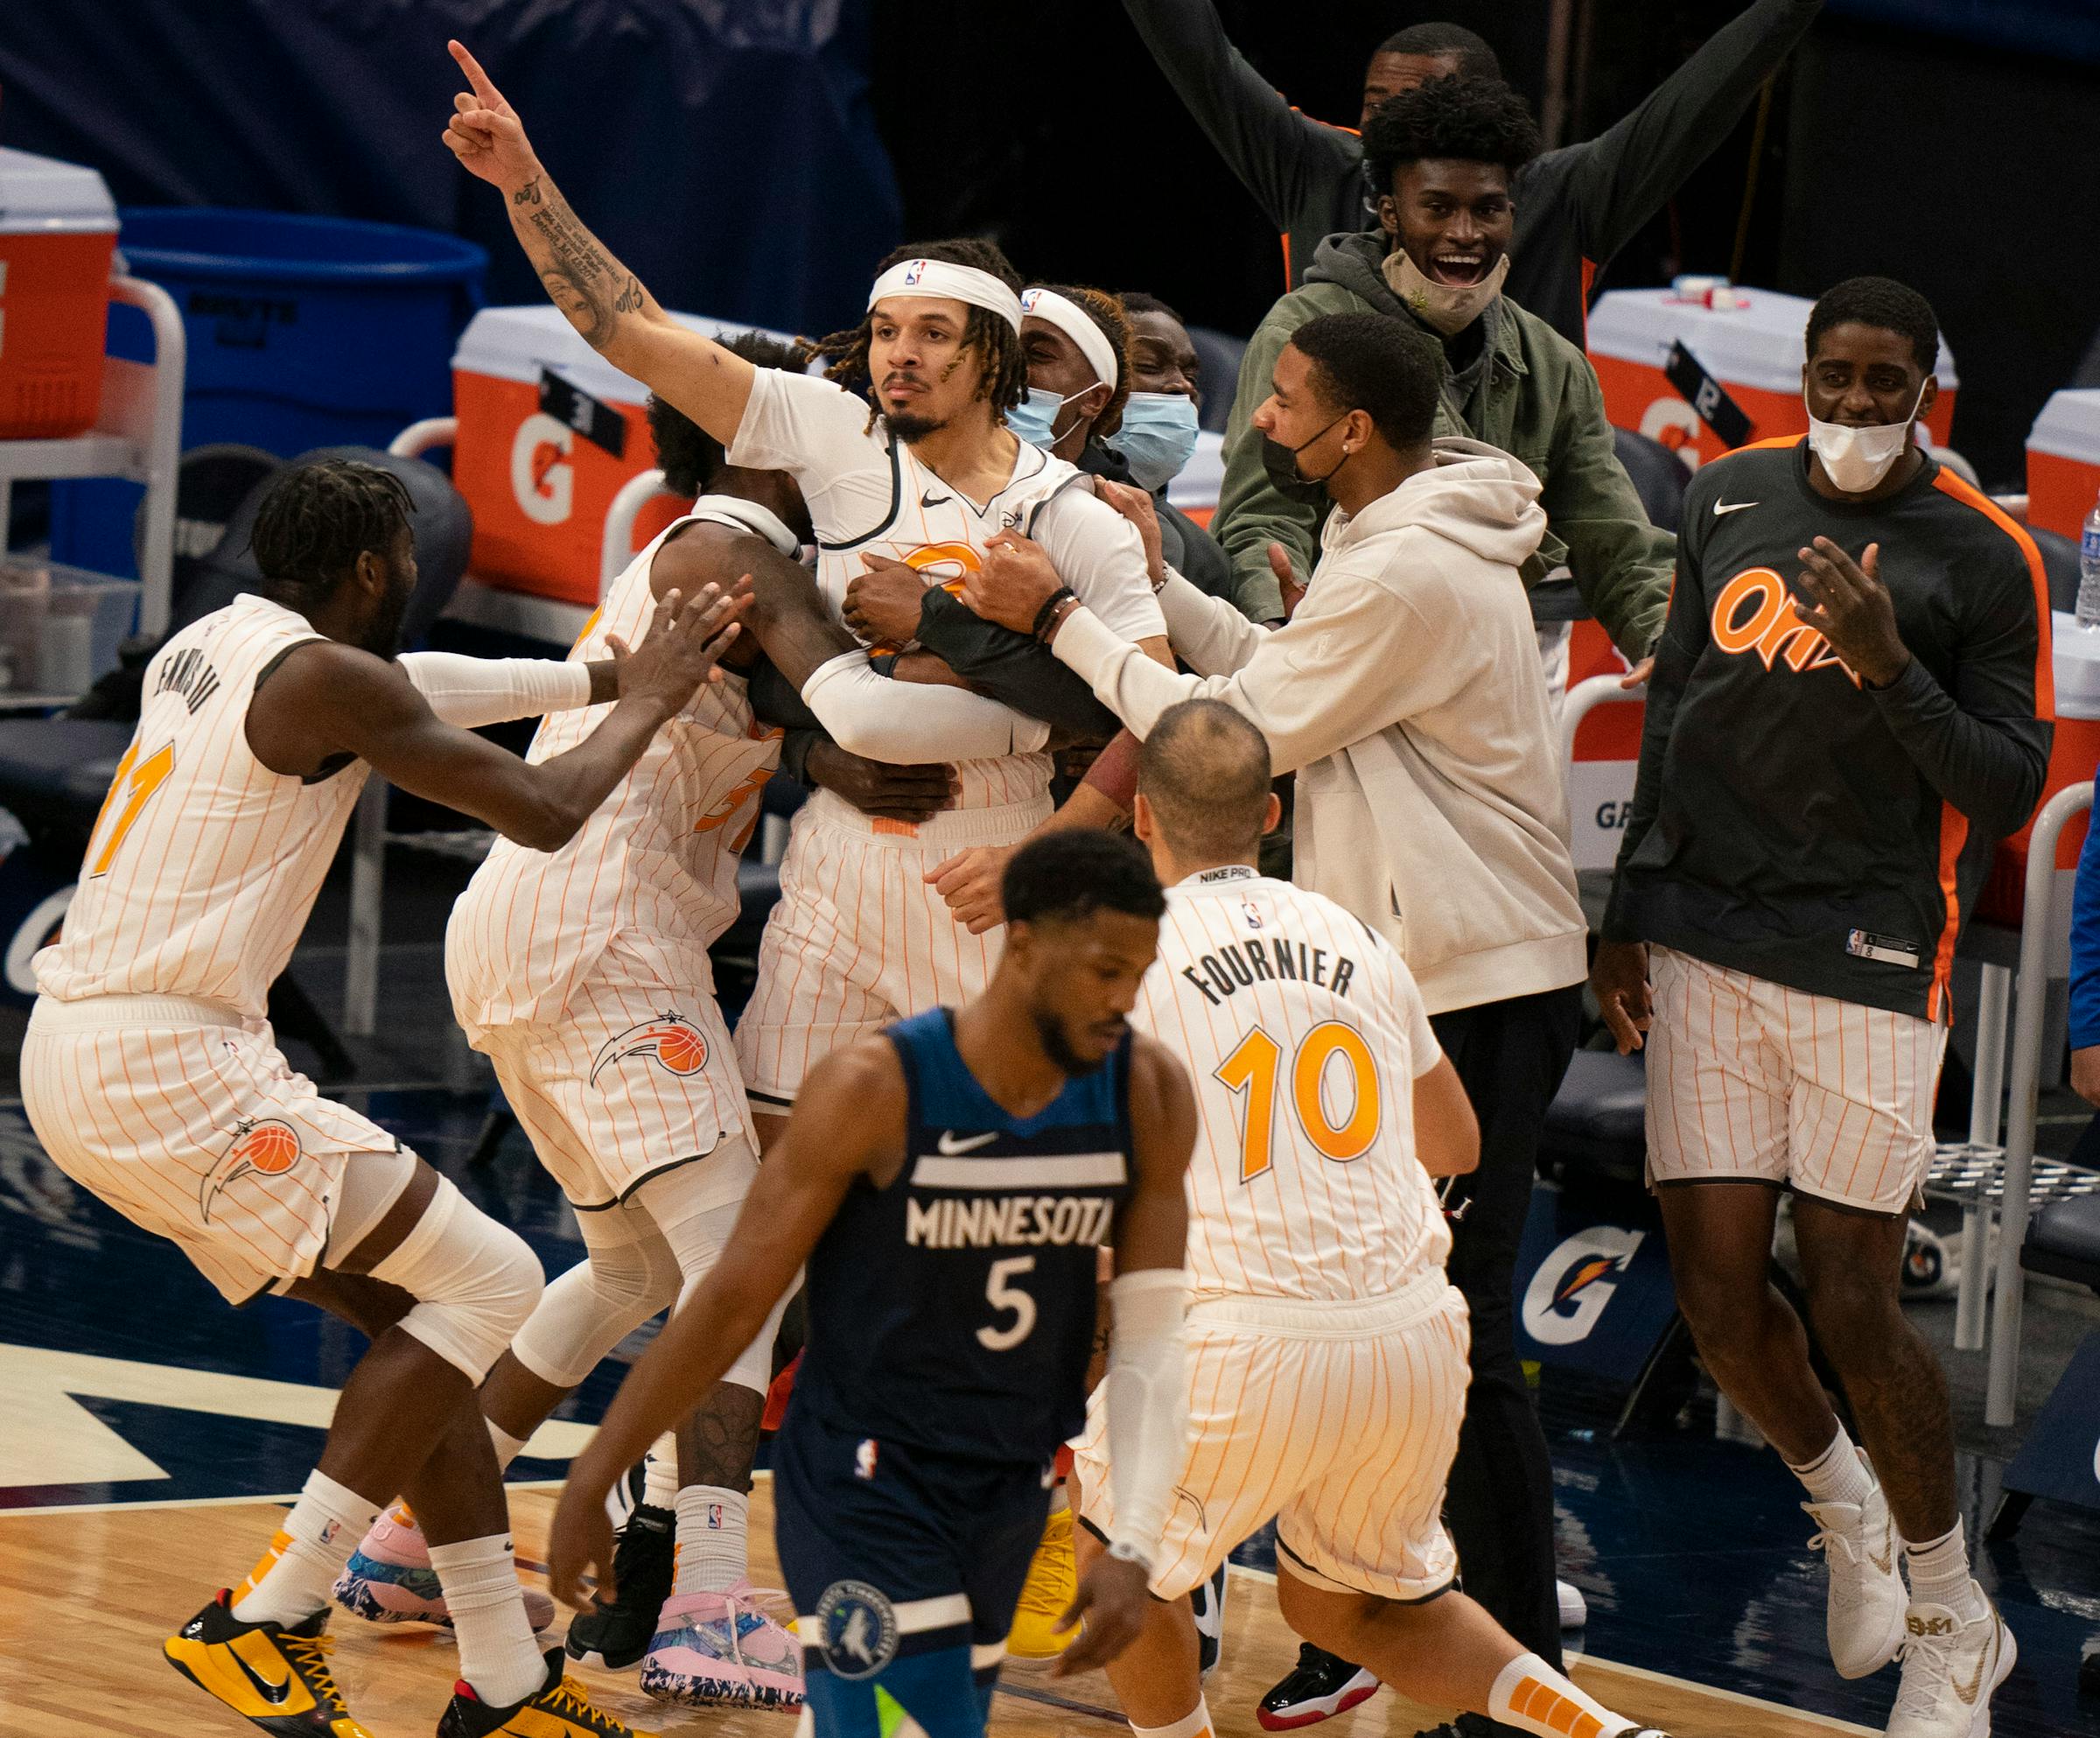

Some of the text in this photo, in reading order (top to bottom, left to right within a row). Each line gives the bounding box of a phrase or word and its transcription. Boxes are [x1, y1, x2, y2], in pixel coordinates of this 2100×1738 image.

[1200, 867, 1250, 883] NIKE PRO
[1181, 937, 1354, 1006] FOURNIER
[1212, 1020, 1382, 1186] 10
[975, 1254, 1038, 1351] 5
[1522, 1225, 1646, 1346] G
